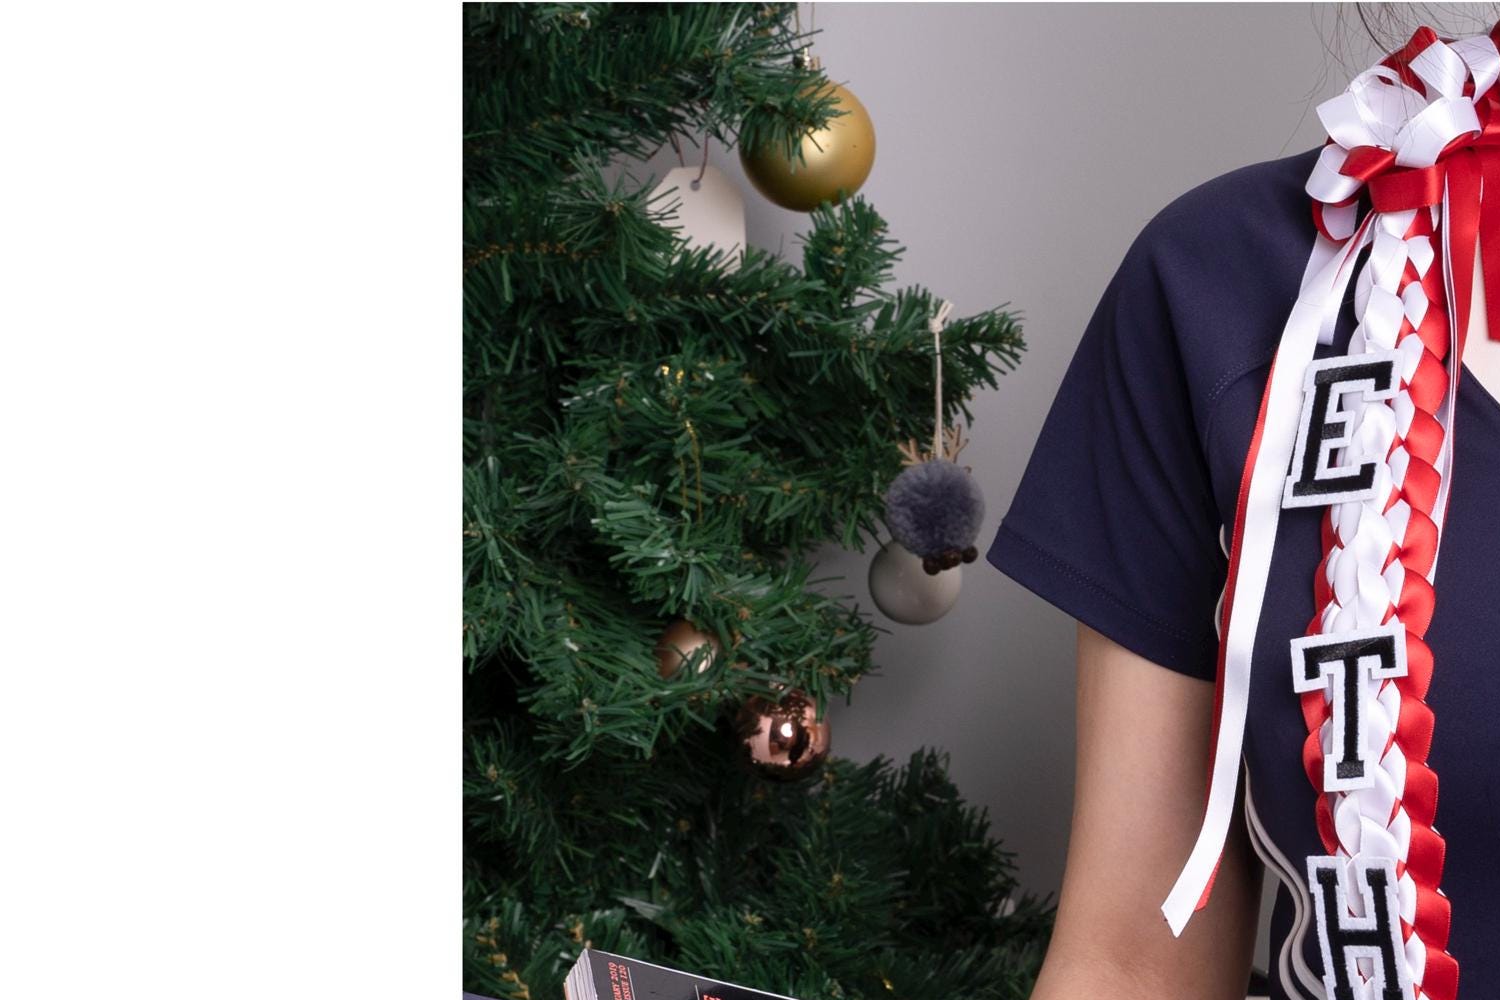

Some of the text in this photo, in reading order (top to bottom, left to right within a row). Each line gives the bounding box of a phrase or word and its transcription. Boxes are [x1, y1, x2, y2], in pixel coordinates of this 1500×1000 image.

[1288, 355, 1398, 500] E
[1299, 632, 1401, 783] T
[608, 962, 618, 981] 2019
[618, 965, 632, 1000] ISSUE 120
